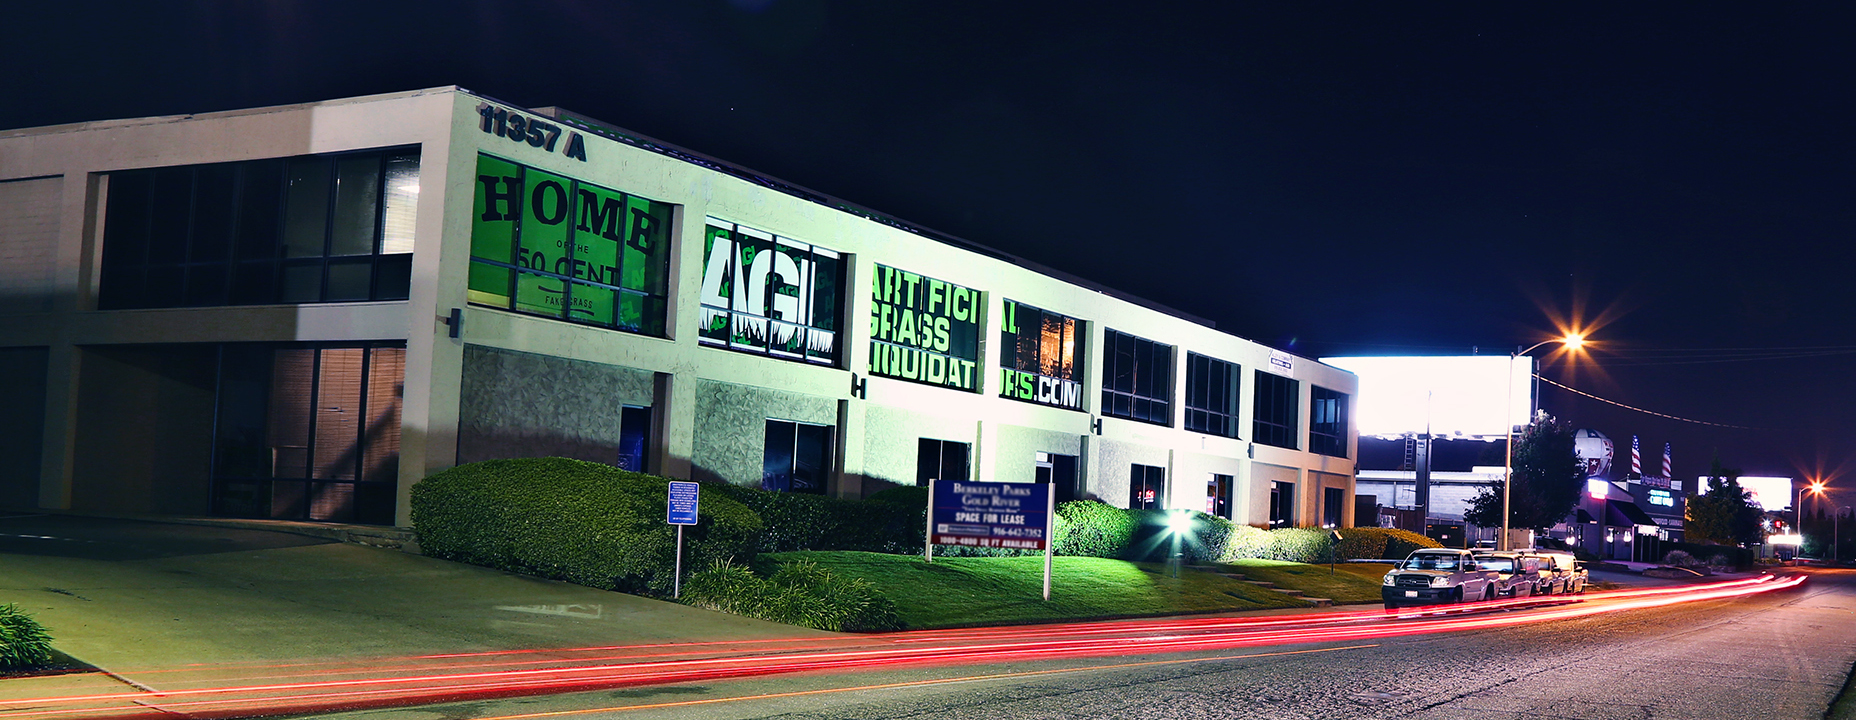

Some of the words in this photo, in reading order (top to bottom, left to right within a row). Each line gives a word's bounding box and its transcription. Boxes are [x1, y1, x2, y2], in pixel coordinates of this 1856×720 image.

[476, 102, 562, 152] 11357
[563, 131, 587, 162] A
[478, 174, 661, 257] HOME
[519, 247, 546, 277] 50
[555, 257, 621, 292] CENT
[871, 263, 978, 325] ARTFICI
[870, 300, 951, 352] GRASS
[867, 341, 976, 389] IQUIDAT
[953, 483, 999, 495] BERKELEY
[1003, 485, 1031, 496] PARKS
[962, 495, 989, 506] GOLD
[992, 496, 1020, 507] RIVER
[955, 512, 980, 522] SPACE
[983, 513, 998, 523] FOR
[1001, 514, 1025, 525] LEASE
[980, 539, 990, 548] SQ
[991, 539, 1000, 547] FT
[1002, 540, 1038, 549] AVAILABLE
